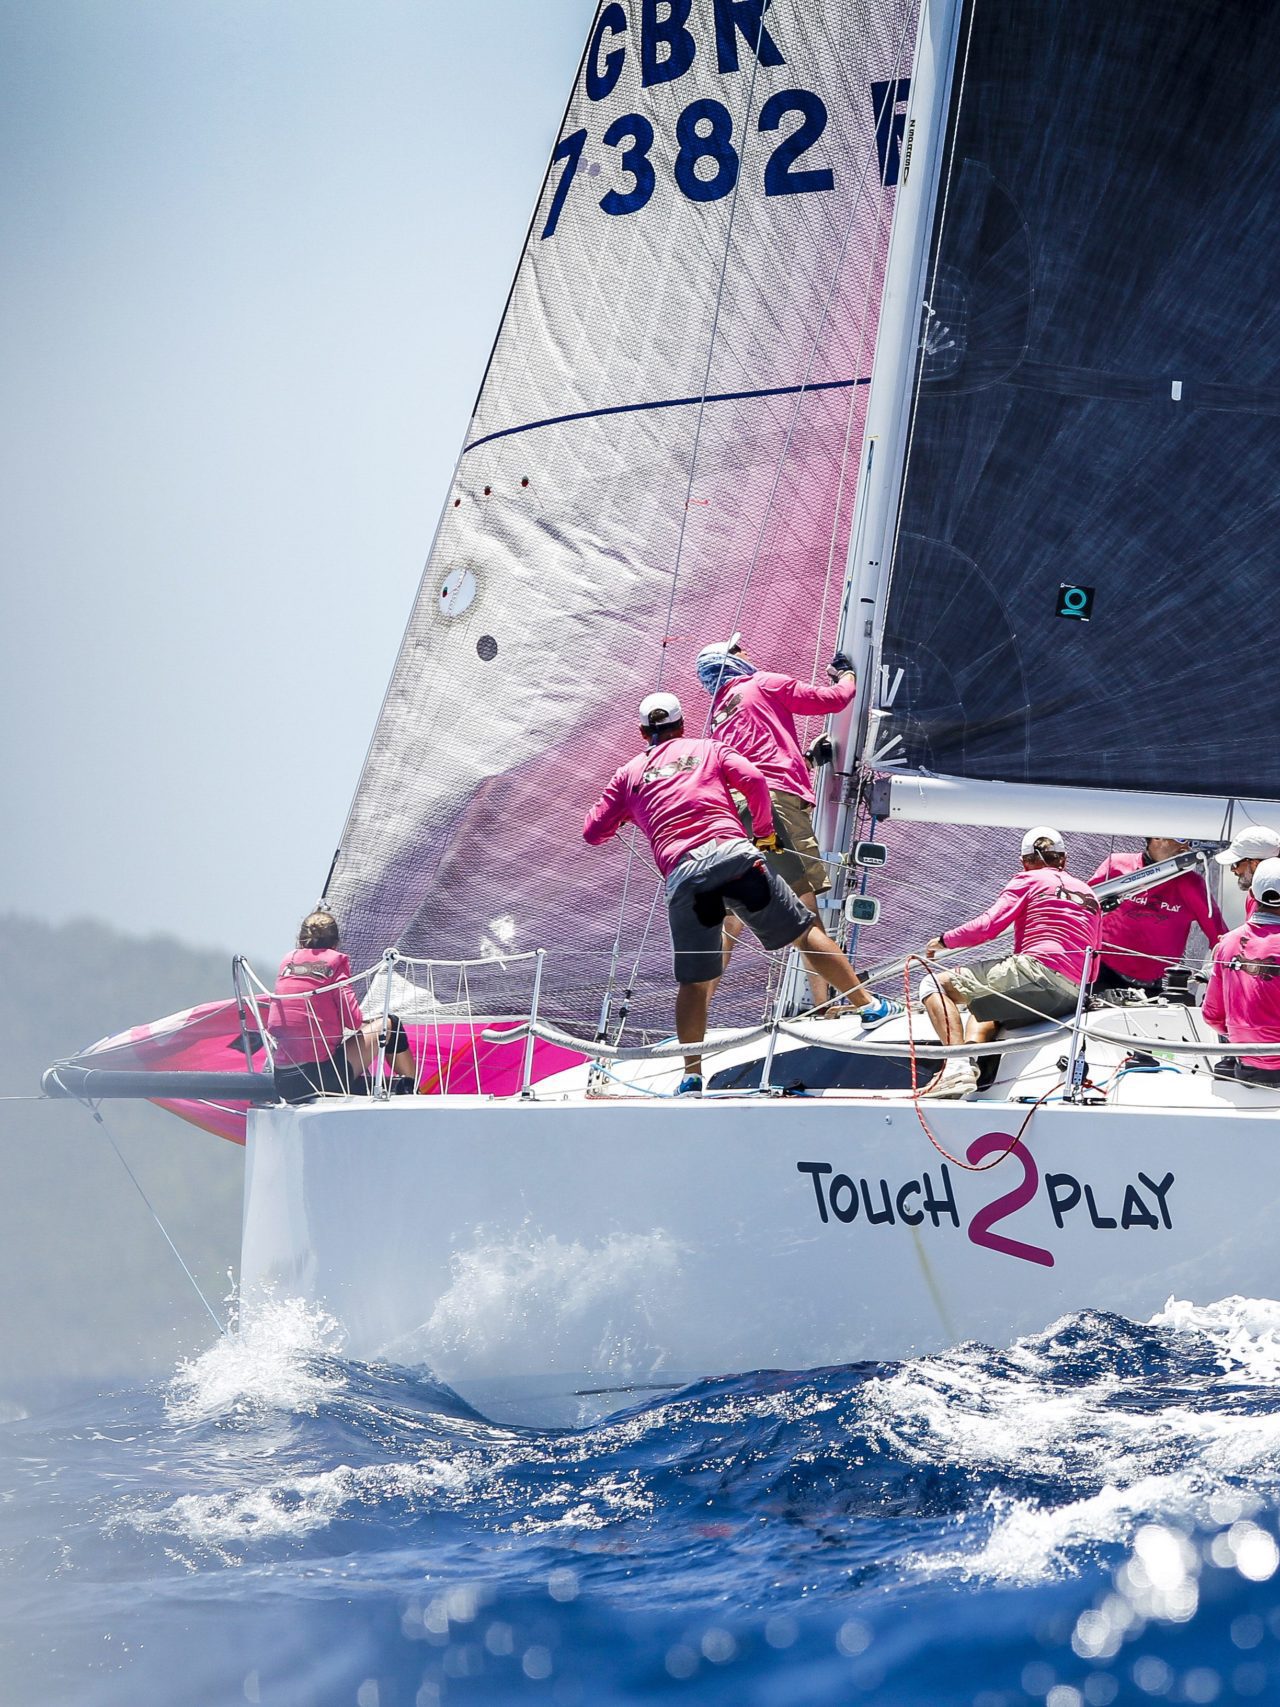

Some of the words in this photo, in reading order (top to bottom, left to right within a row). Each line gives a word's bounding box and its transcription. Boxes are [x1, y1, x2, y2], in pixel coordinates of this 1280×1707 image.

[586, 0, 786, 101] GBR
[1160, 901, 1182, 913] PLAY
[797, 1161, 960, 1228] TOUCH
[966, 1132, 1054, 1267] 2
[1045, 1172, 1174, 1229] PLAY
